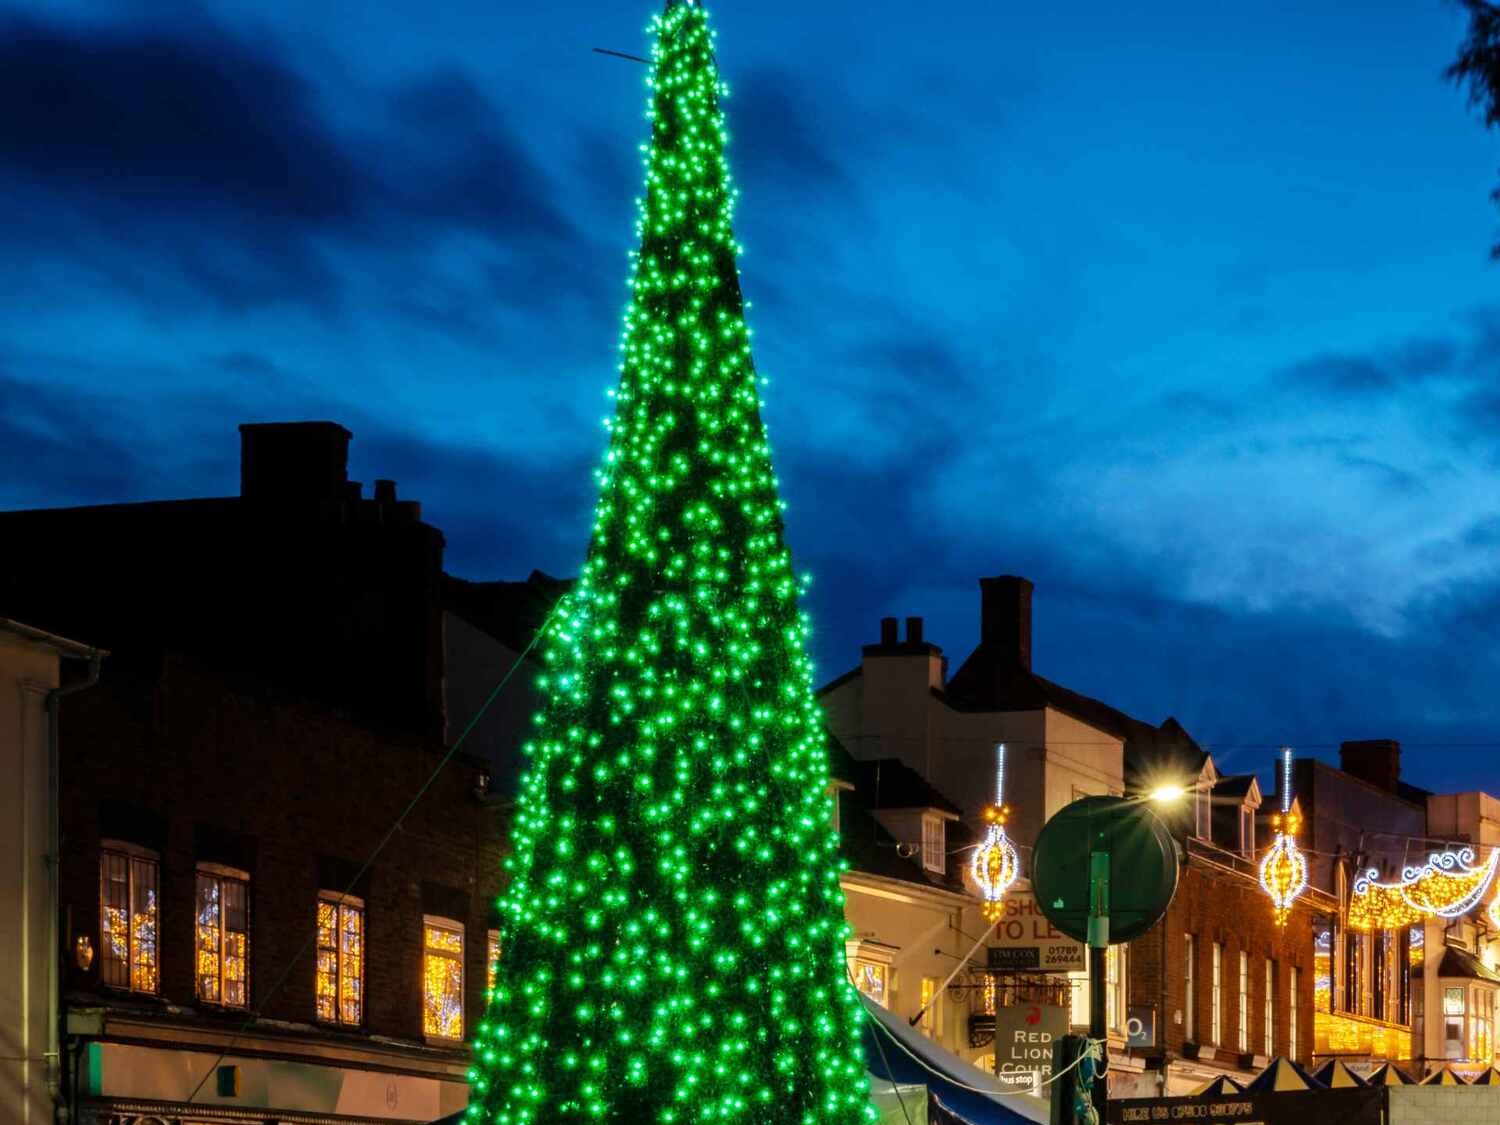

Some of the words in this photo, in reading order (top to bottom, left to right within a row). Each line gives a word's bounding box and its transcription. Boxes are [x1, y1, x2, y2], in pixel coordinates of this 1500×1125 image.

[996, 919, 1025, 940] TO
[1033, 919, 1062, 939] LE
[1048, 946, 1078, 954] 01789
[1127, 1017, 1147, 1040] O2
[1014, 1030, 1051, 1043] RED
[1011, 1046, 1052, 1060] LION
[1001, 1062, 1052, 1075] COUR
[1016, 1074, 1033, 1088] stop
